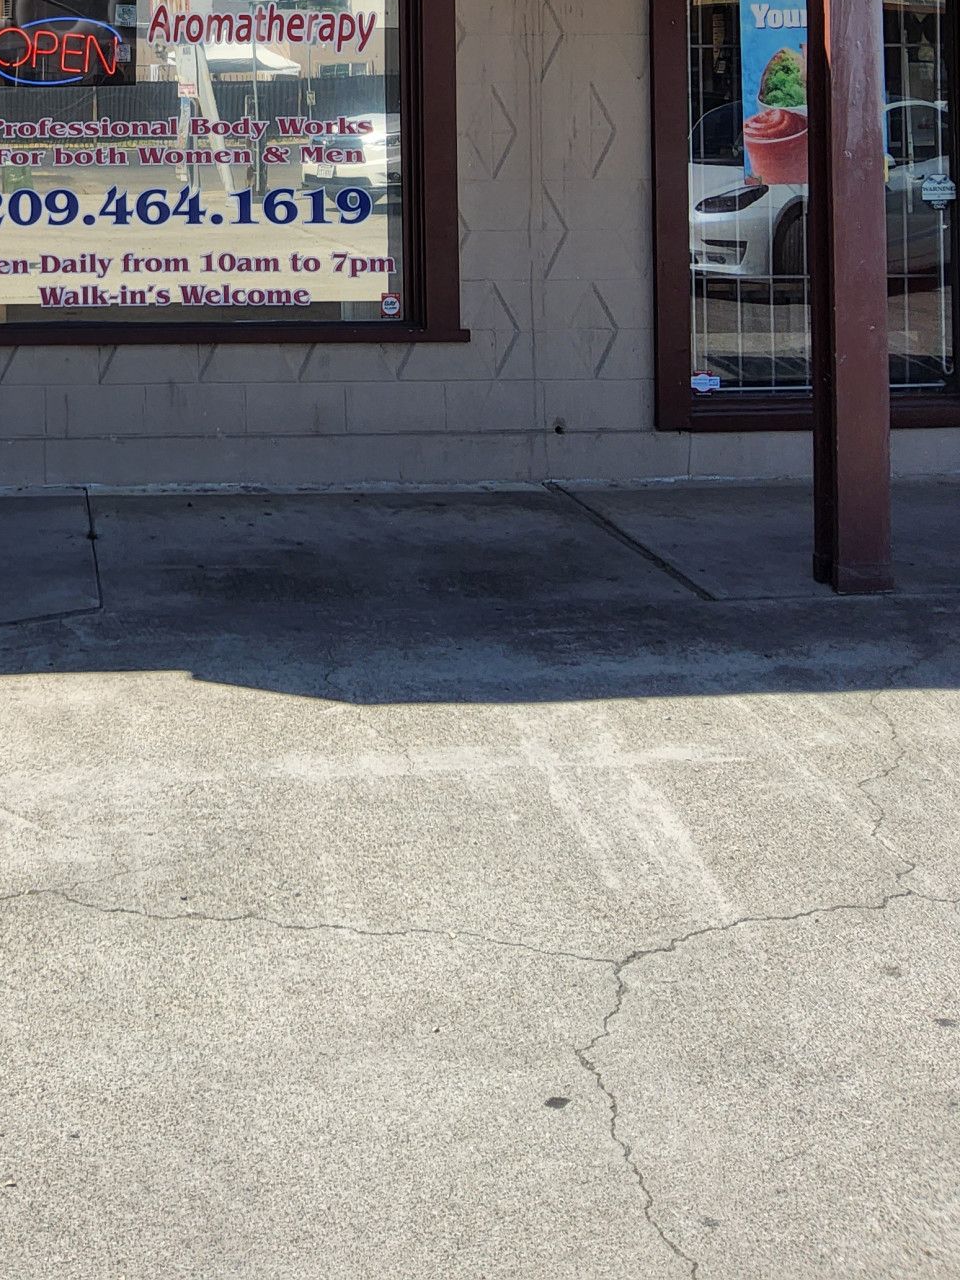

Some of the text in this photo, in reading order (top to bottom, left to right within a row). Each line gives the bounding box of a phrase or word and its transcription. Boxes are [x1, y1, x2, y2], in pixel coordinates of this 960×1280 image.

[148, 3, 376, 53] Aromatherapy
[190, 118, 269, 140] Body
[279, 117, 374, 137] Works
[53, 147, 127, 167] both
[139, 146, 252, 166] Women
[262, 146, 291, 165] &
[300, 145, 367, 165] Men
[40, 253, 111, 278] Daily
[121, 253, 189, 274] from
[199, 253, 280, 273] 10am
[290, 253, 321, 273] to
[331, 251, 396, 278] 7pm
[38, 284, 311, 307] Walk-in's Welcome
